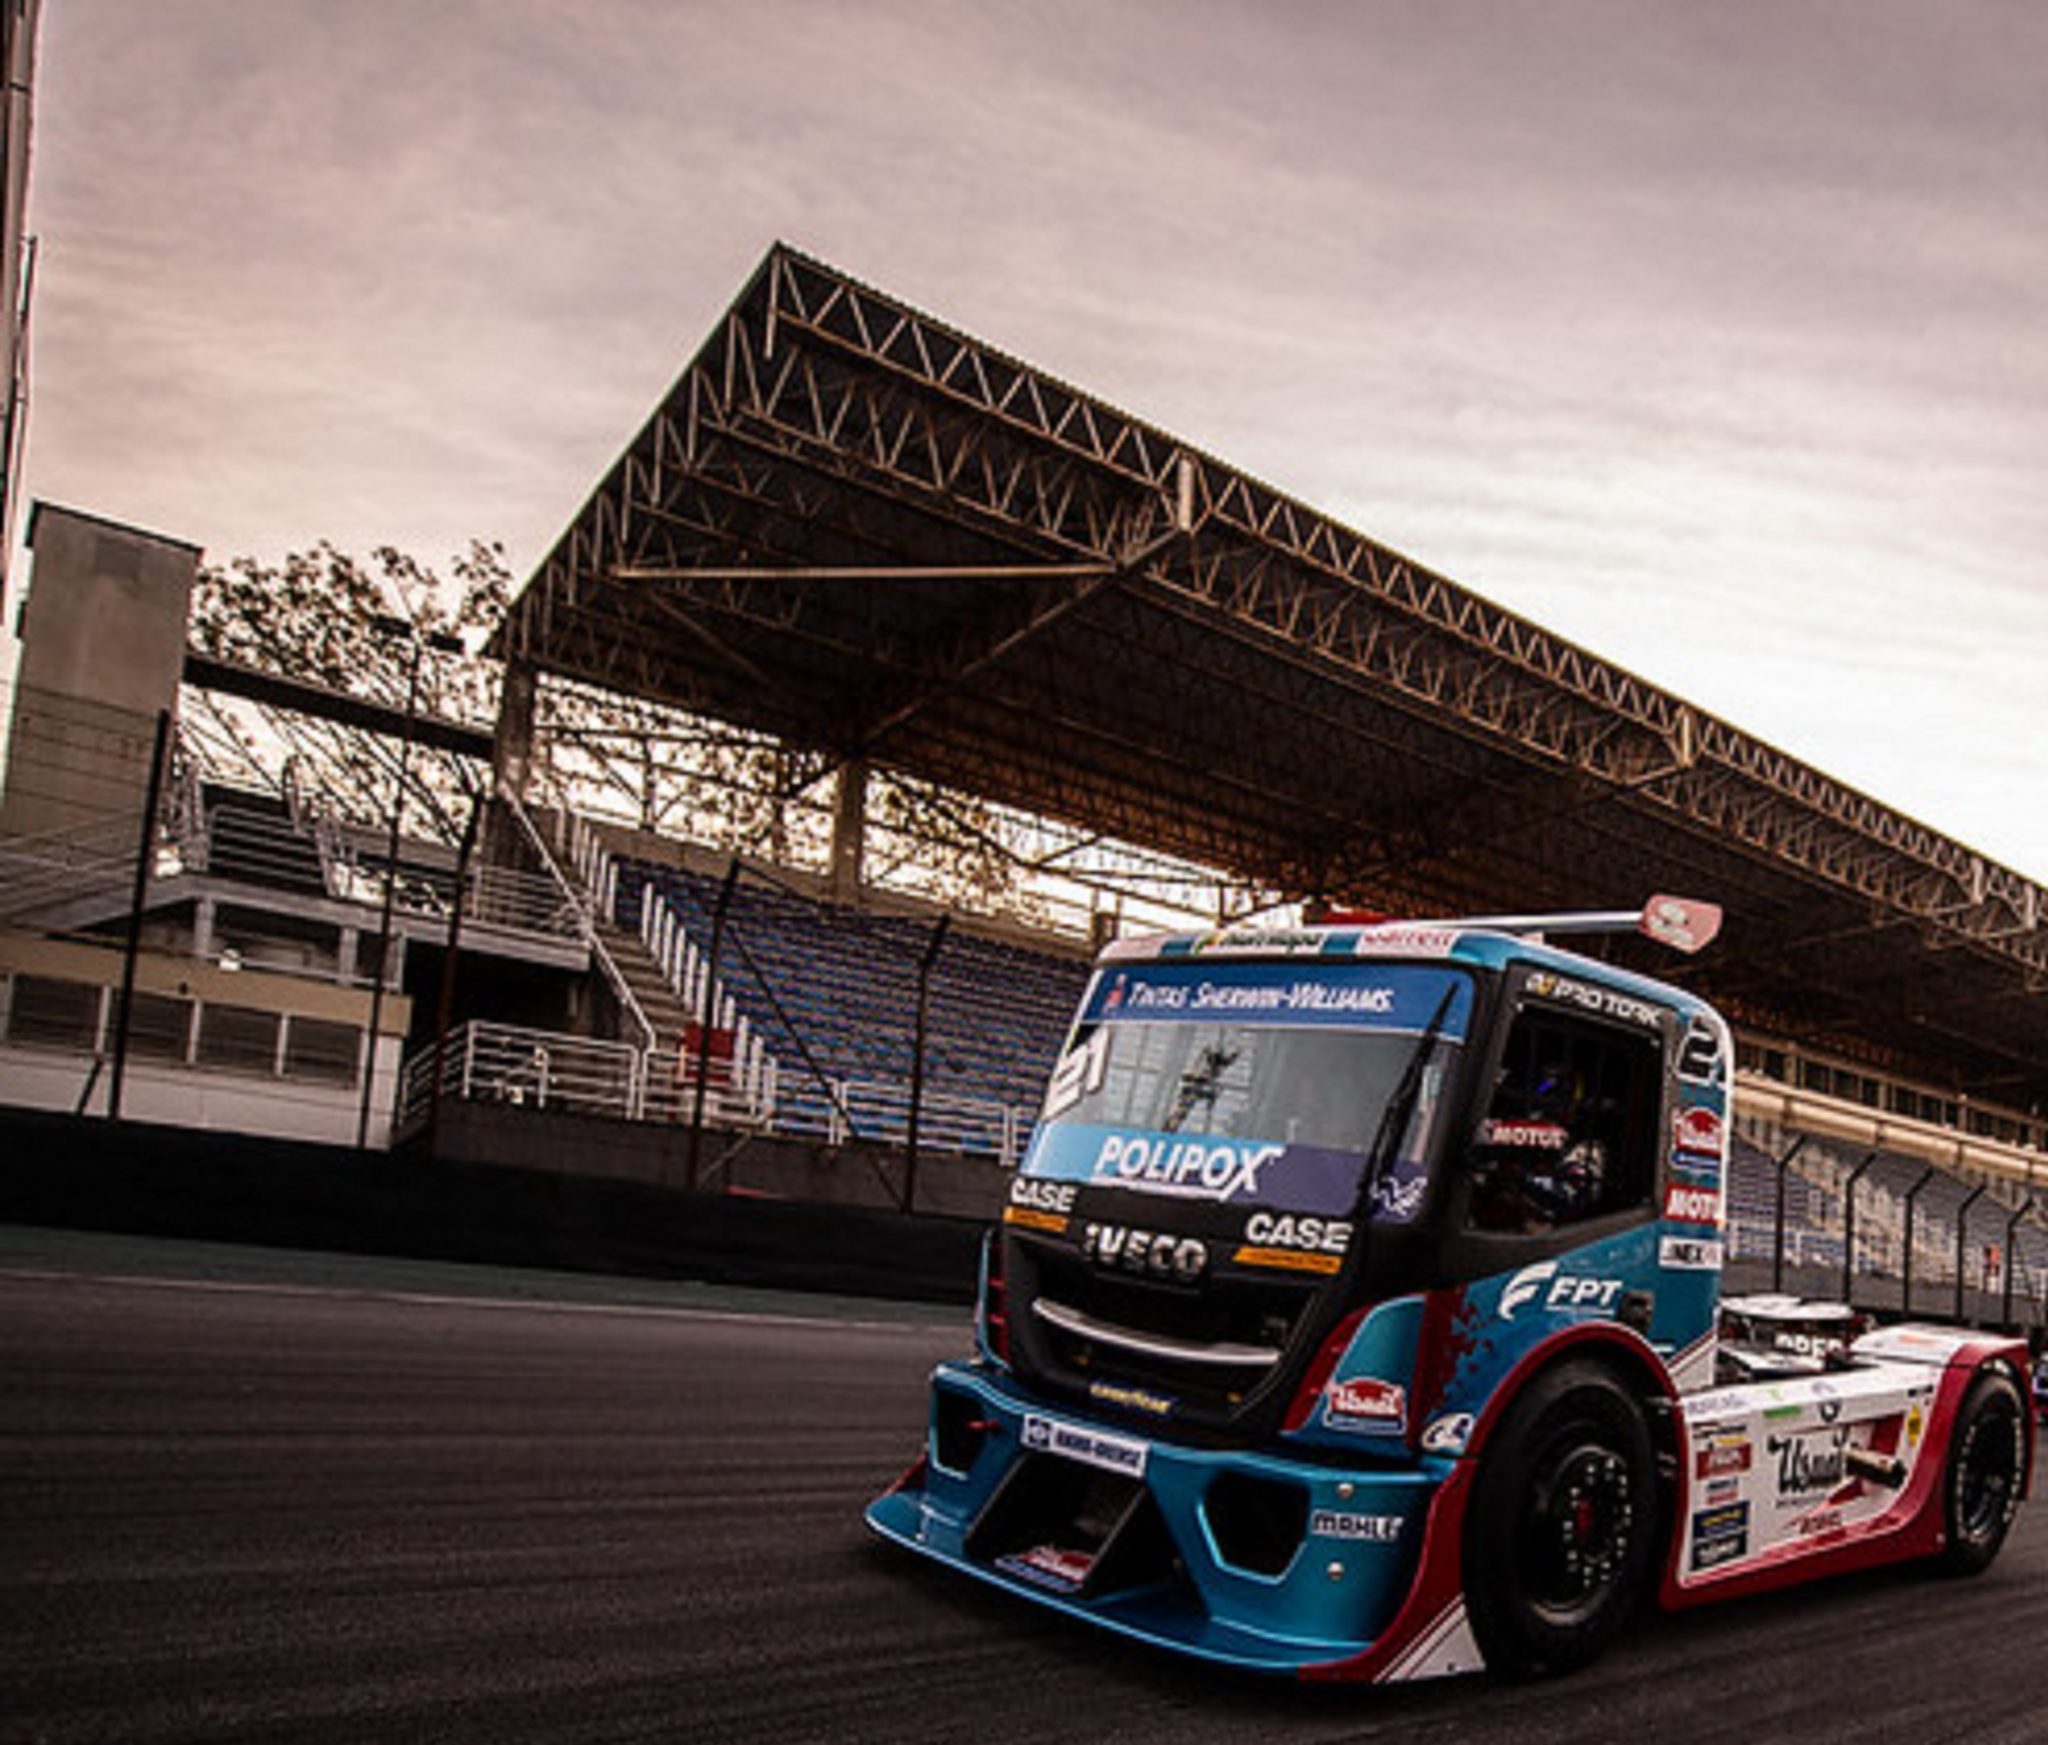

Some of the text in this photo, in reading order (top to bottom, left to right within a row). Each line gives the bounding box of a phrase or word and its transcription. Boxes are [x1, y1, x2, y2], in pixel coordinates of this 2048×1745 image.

[1094, 1134, 1286, 1202] POLIPOX
[1011, 1178, 1077, 1212] CASE
[1084, 1222, 1209, 1276] IVECO
[1245, 1213, 1354, 1253] CASE
[1547, 1276, 1624, 1307] FPT
